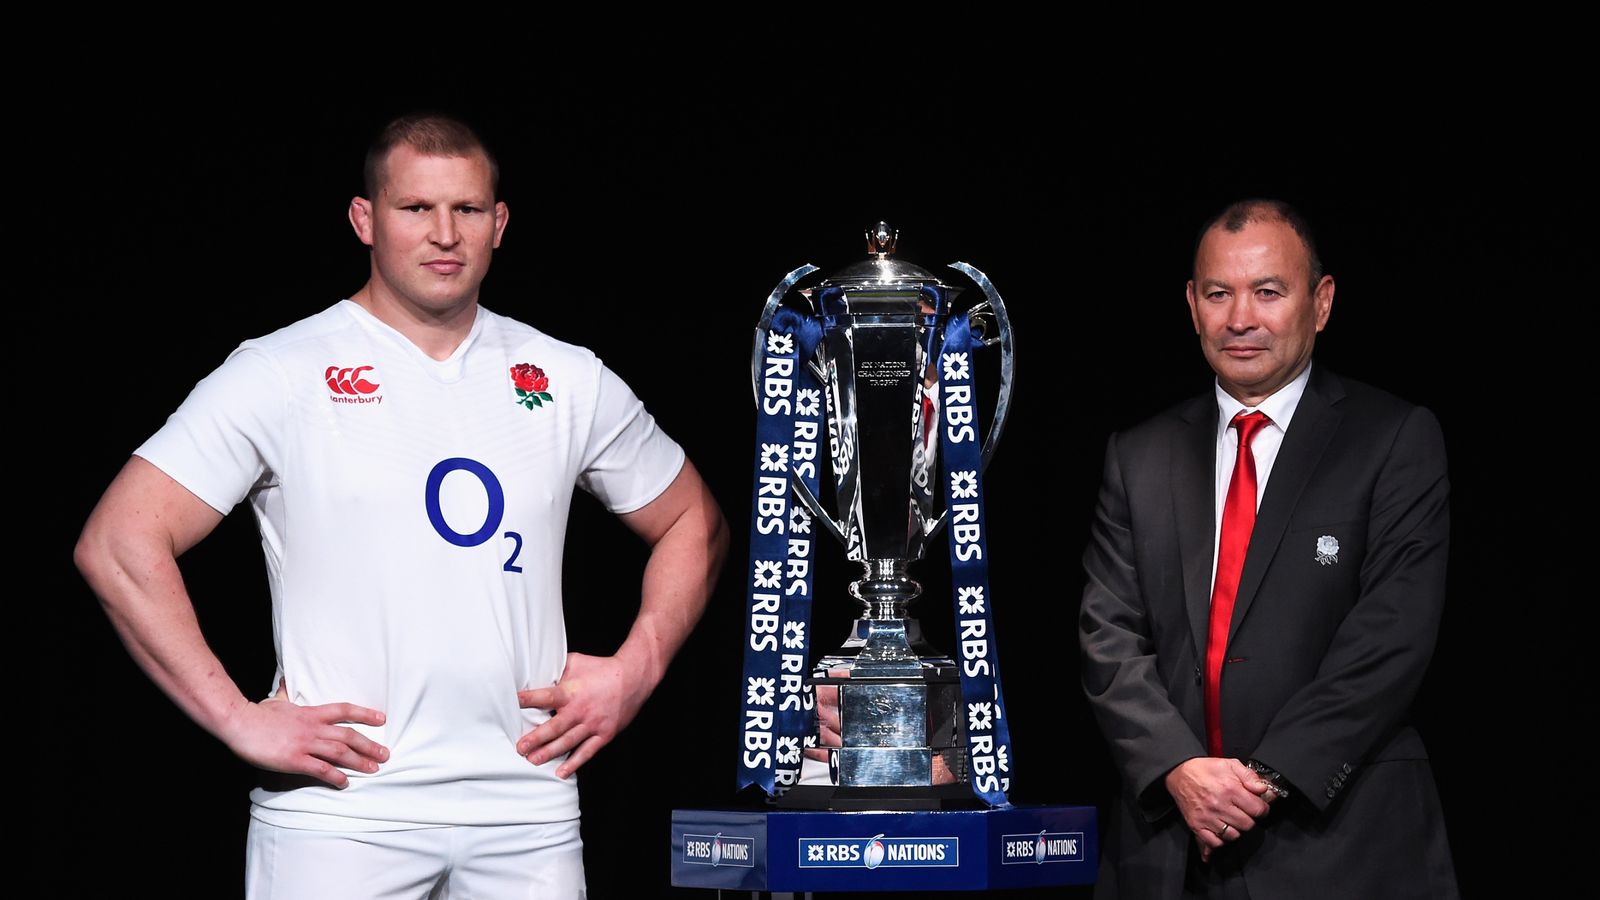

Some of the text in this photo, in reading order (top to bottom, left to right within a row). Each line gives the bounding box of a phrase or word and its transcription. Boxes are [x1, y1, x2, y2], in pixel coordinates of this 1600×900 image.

[743, 357, 794, 769] RBS RBS RBS RBS
[778, 421, 819, 712] RBS RBS RBS
[944, 385, 1000, 794] RBS RBS RBS RBS
[695, 841, 711, 858] RBS
[721, 843, 748, 861] NATIONS
[826, 844, 860, 861] RBS
[888, 844, 946, 861] NATIONS
[1016, 840, 1034, 857] RBS
[1047, 839, 1077, 856] NATIONS
